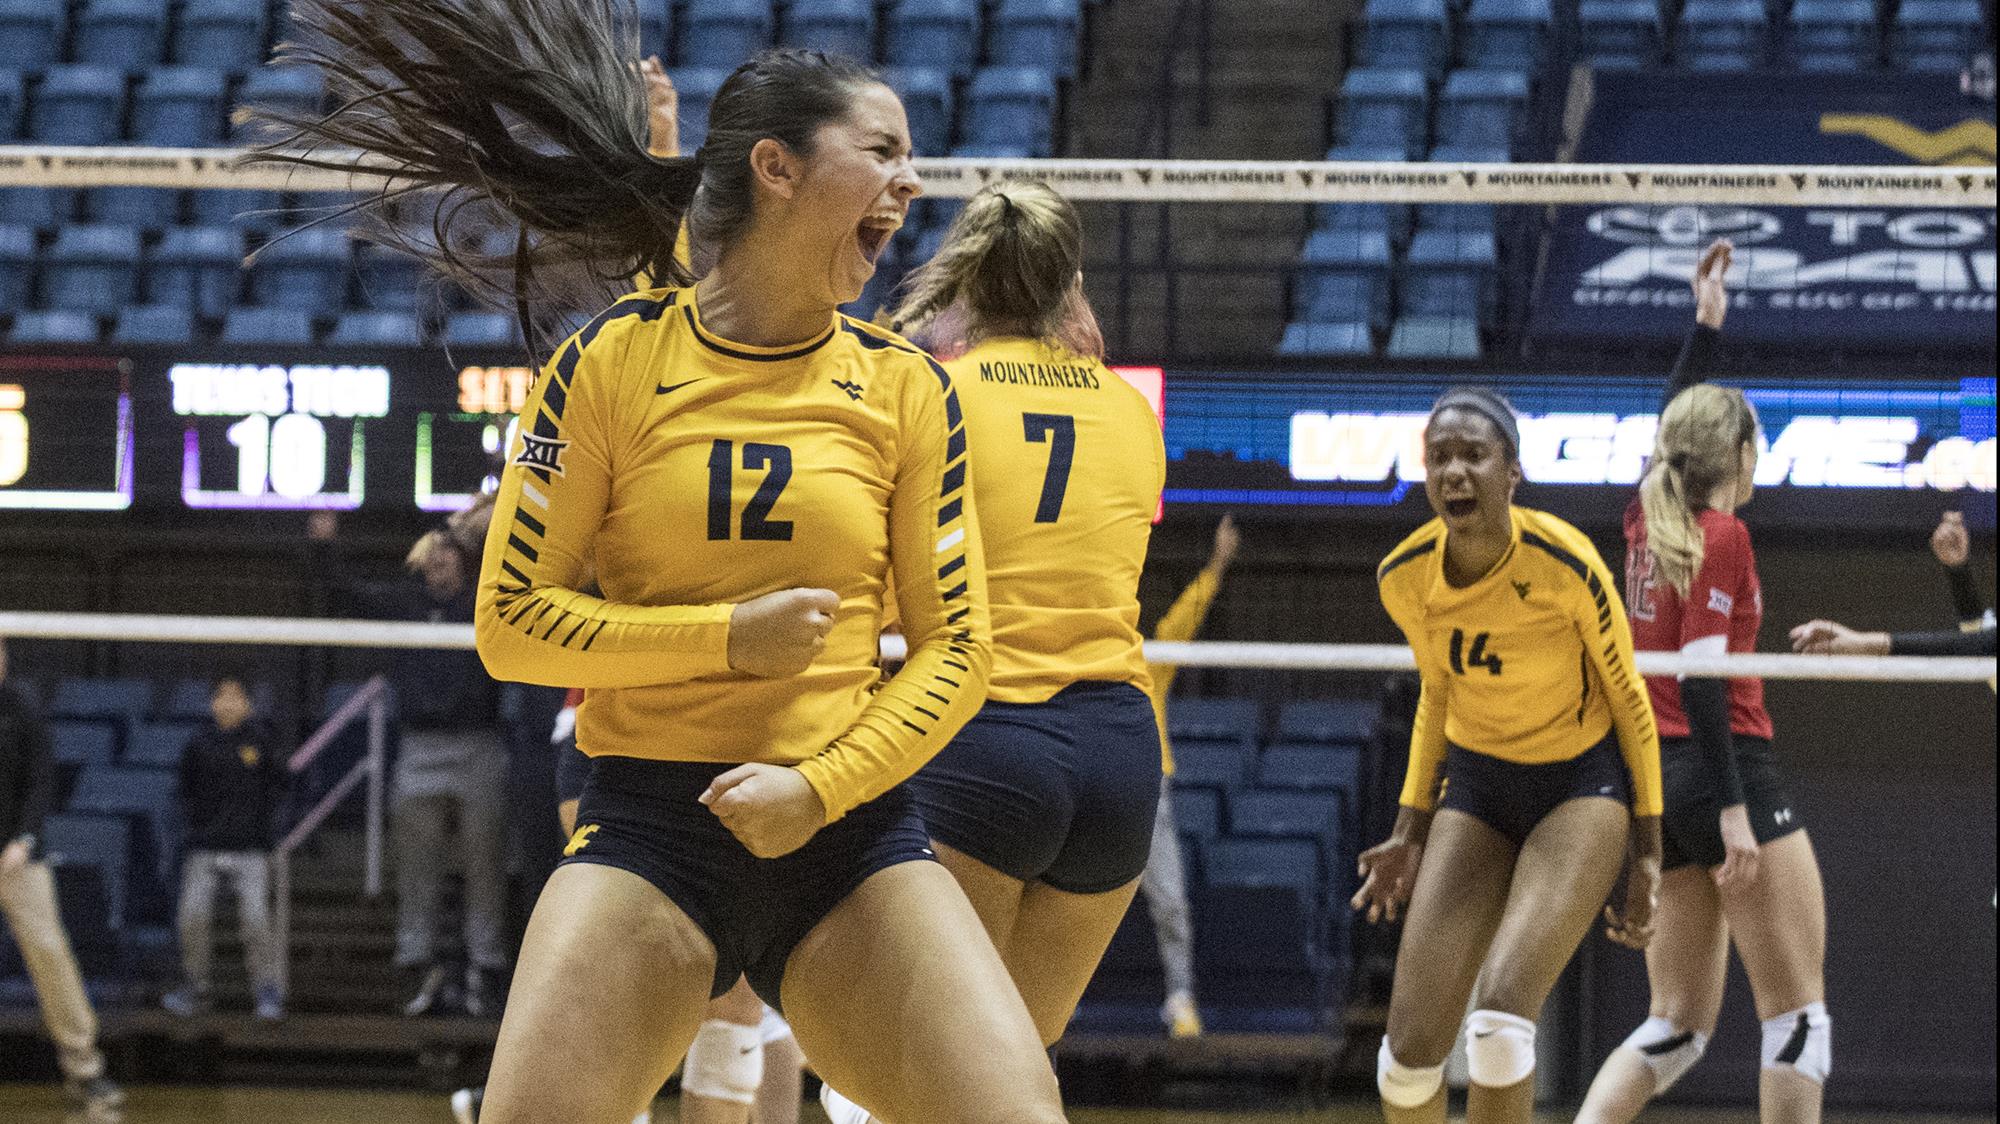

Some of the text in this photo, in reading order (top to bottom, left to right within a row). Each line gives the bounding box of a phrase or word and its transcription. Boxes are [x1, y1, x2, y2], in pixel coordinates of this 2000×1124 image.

[1163, 169, 1285, 184] MOUNTAINEERS
[1325, 170, 1448, 186] MOUNTAINEERS
[1487, 172, 1612, 187] MOUNTAINEERS
[1651, 175, 1777, 189] MOUNTAINEERS
[1816, 176, 1943, 190] MOUNTAINEERS
[1807, 210, 1996, 246] TO
[1580, 246, 1996, 290] RA
[979, 361, 1101, 390] MOUNTAINEERS
[227, 413, 326, 499] 10
[516, 433, 568, 474] XII
[1022, 412, 1076, 523] 7
[707, 438, 794, 541] 12
[1450, 627, 1503, 675] 14
